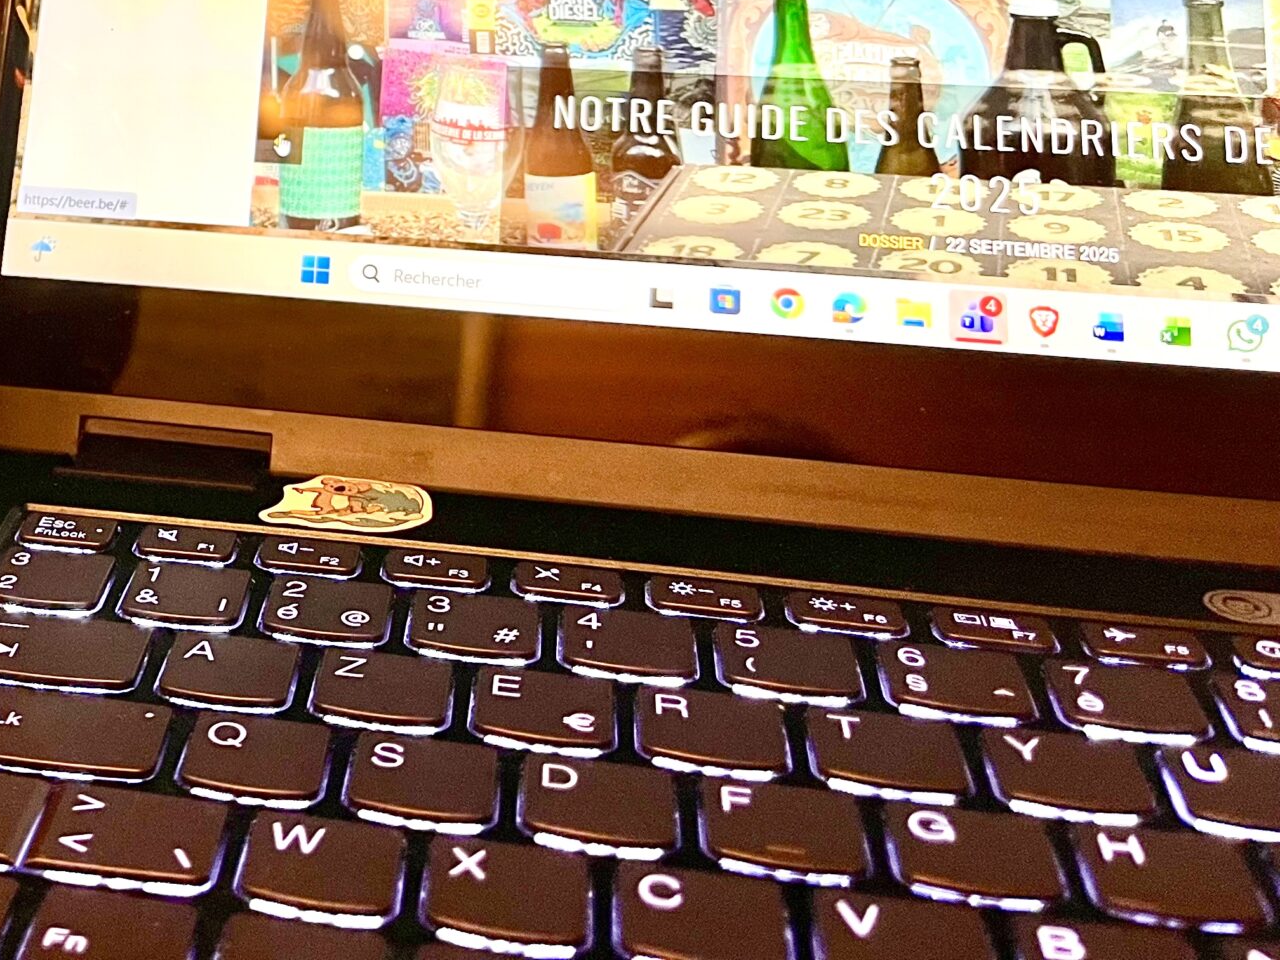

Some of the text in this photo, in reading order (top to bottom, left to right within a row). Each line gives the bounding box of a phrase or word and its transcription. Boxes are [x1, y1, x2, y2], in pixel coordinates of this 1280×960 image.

[548, 4, 602, 21] DIESEL
[554, 95, 1274, 164] NOTRE GUIDE DES CALENDRIERS DE
[24, 194, 128, 212] https://beer.be/#
[930, 173, 1041, 215] 2025
[798, 208, 851, 220] 23
[1158, 229, 1202, 242] 15
[859, 233, 924, 250] DOSSIER
[946, 237, 967, 253] 22
[969, 238, 1076, 260] SEPTEMBRE
[1080, 246, 1120, 263] 2025
[898, 258, 963, 274] 20
[394, 269, 481, 289] Rechercher
[38, 516, 77, 529] Esc
[196, 543, 215, 552] F1
[319, 556, 340, 566] F2
[148, 566, 161, 583] 1
[448, 569, 469, 579] F3
[581, 582, 602, 593] F4
[720, 598, 741, 609] F5
[340, 610, 371, 627] @
[577, 612, 602, 630] 4
[863, 613, 888, 624] F6
[734, 628, 760, 648] 5
[1012, 630, 1036, 641] F7
[183, 640, 215, 661] A
[897, 647, 926, 667] 6
[334, 655, 368, 678] Z
[1062, 664, 1090, 685] 7
[491, 674, 522, 698] E
[1233, 679, 1267, 702] 8
[655, 693, 689, 719] R
[562, 712, 596, 733] €
[826, 713, 861, 740] T
[207, 721, 248, 748] Q
[370, 742, 405, 768] S
[1002, 734, 1040, 762] Y
[541, 762, 579, 790] D
[1181, 750, 1228, 782] U
[720, 785, 752, 813] F
[907, 810, 957, 842] G
[272, 821, 327, 855] W
[1096, 831, 1146, 865] H
[448, 846, 487, 881] X
[637, 873, 683, 910] C
[835, 899, 880, 938] V
[41, 927, 88, 954] Fn
[1036, 925, 1087, 960] B
